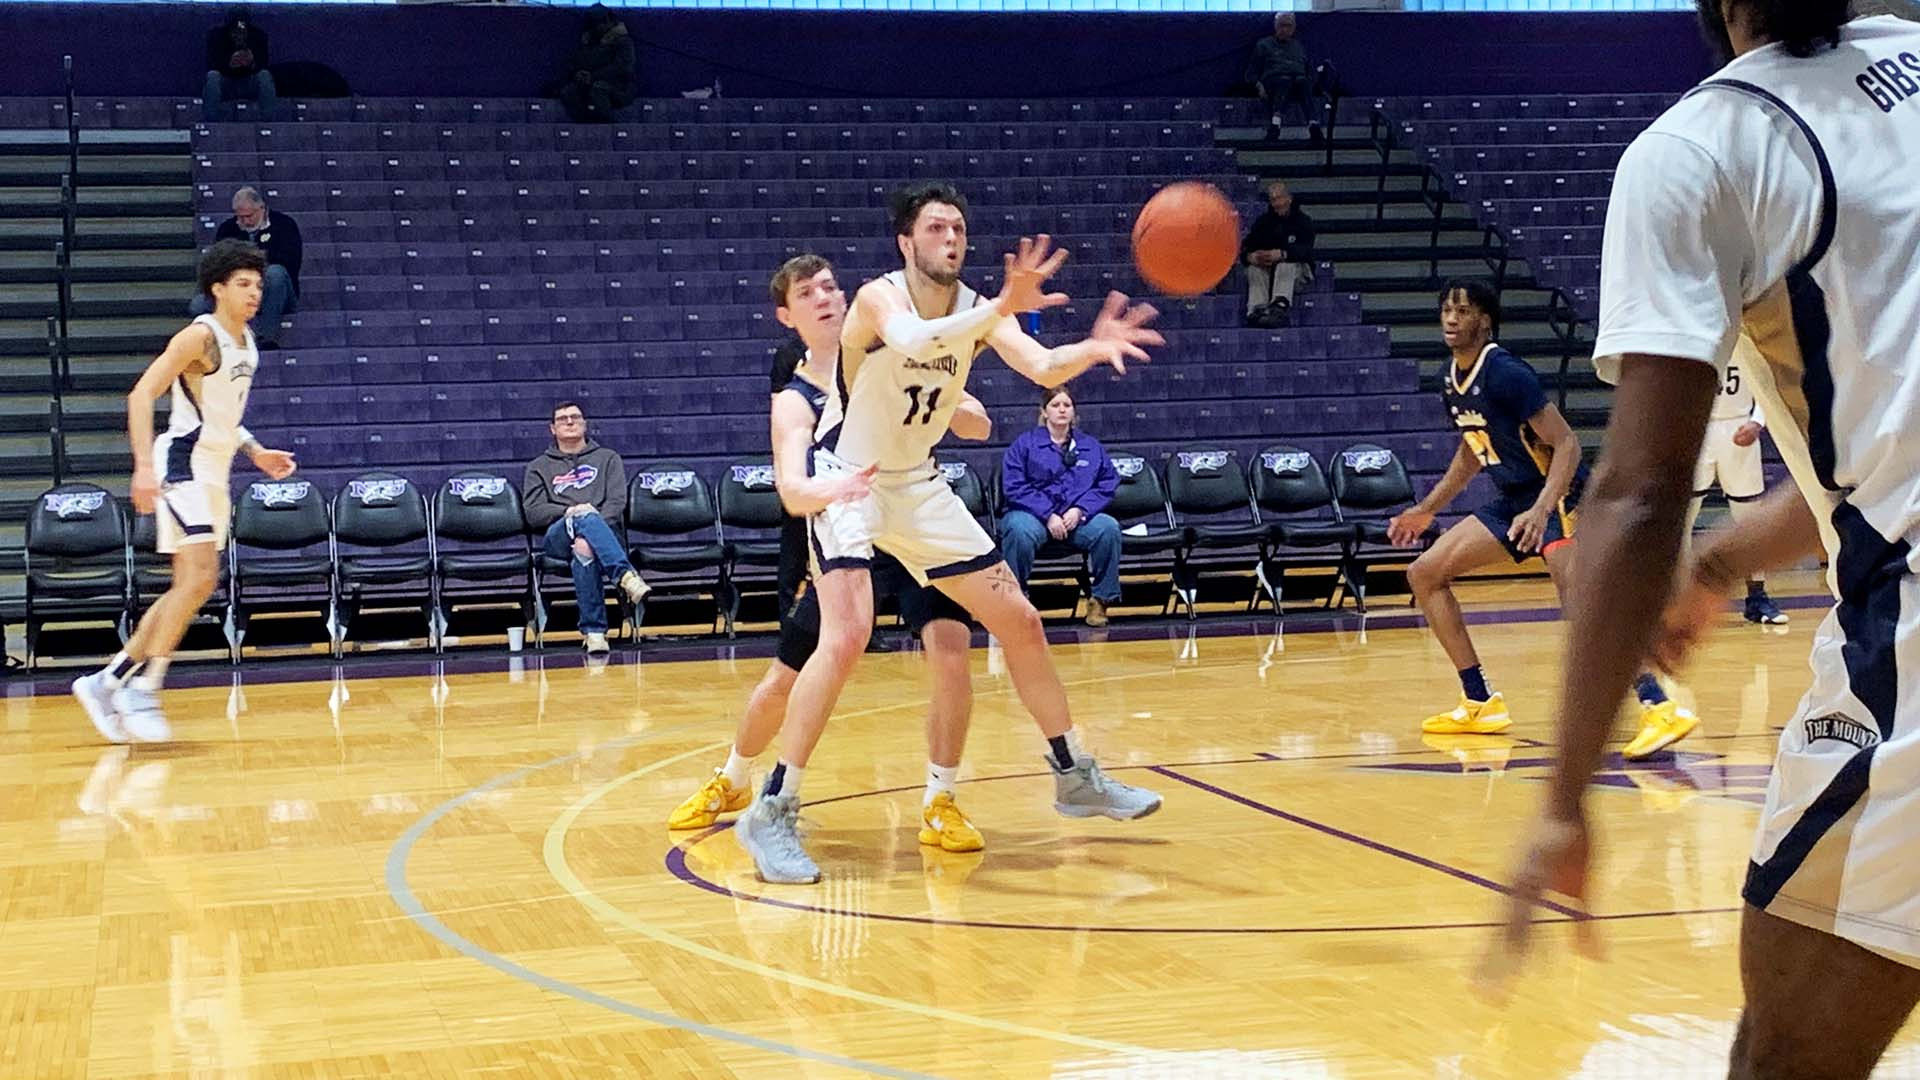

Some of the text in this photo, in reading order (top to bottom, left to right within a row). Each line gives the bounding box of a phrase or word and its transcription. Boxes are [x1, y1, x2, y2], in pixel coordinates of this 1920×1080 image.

[903, 386, 942, 425] 11
[1806, 720, 1877, 748] THE MOUNT
